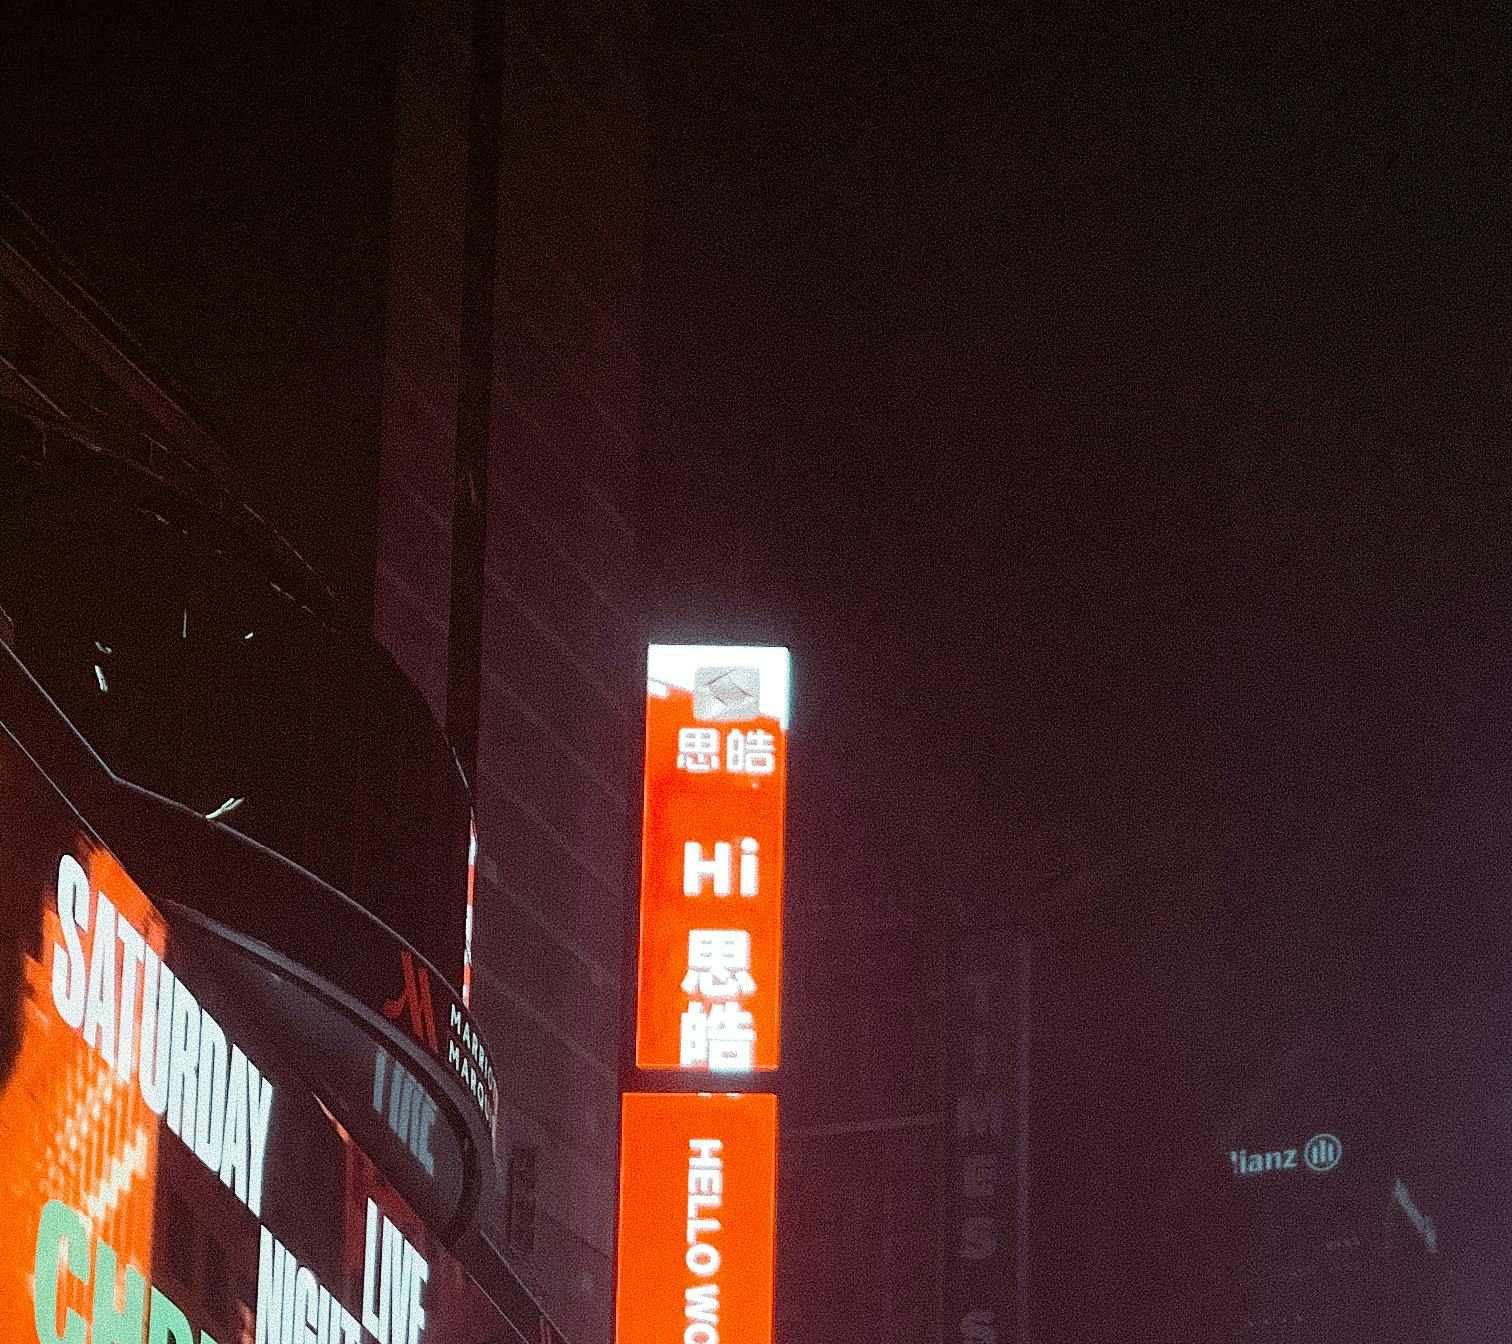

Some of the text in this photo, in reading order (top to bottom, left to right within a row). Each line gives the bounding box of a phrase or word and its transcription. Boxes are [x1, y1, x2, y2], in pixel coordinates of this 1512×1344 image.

[683, 837, 760, 897] Hi
[51, 852, 275, 1219] SATURDAY
[955, 970, 1004, 1261] TIMES
[686, 1138, 724, 1278] HELLO
